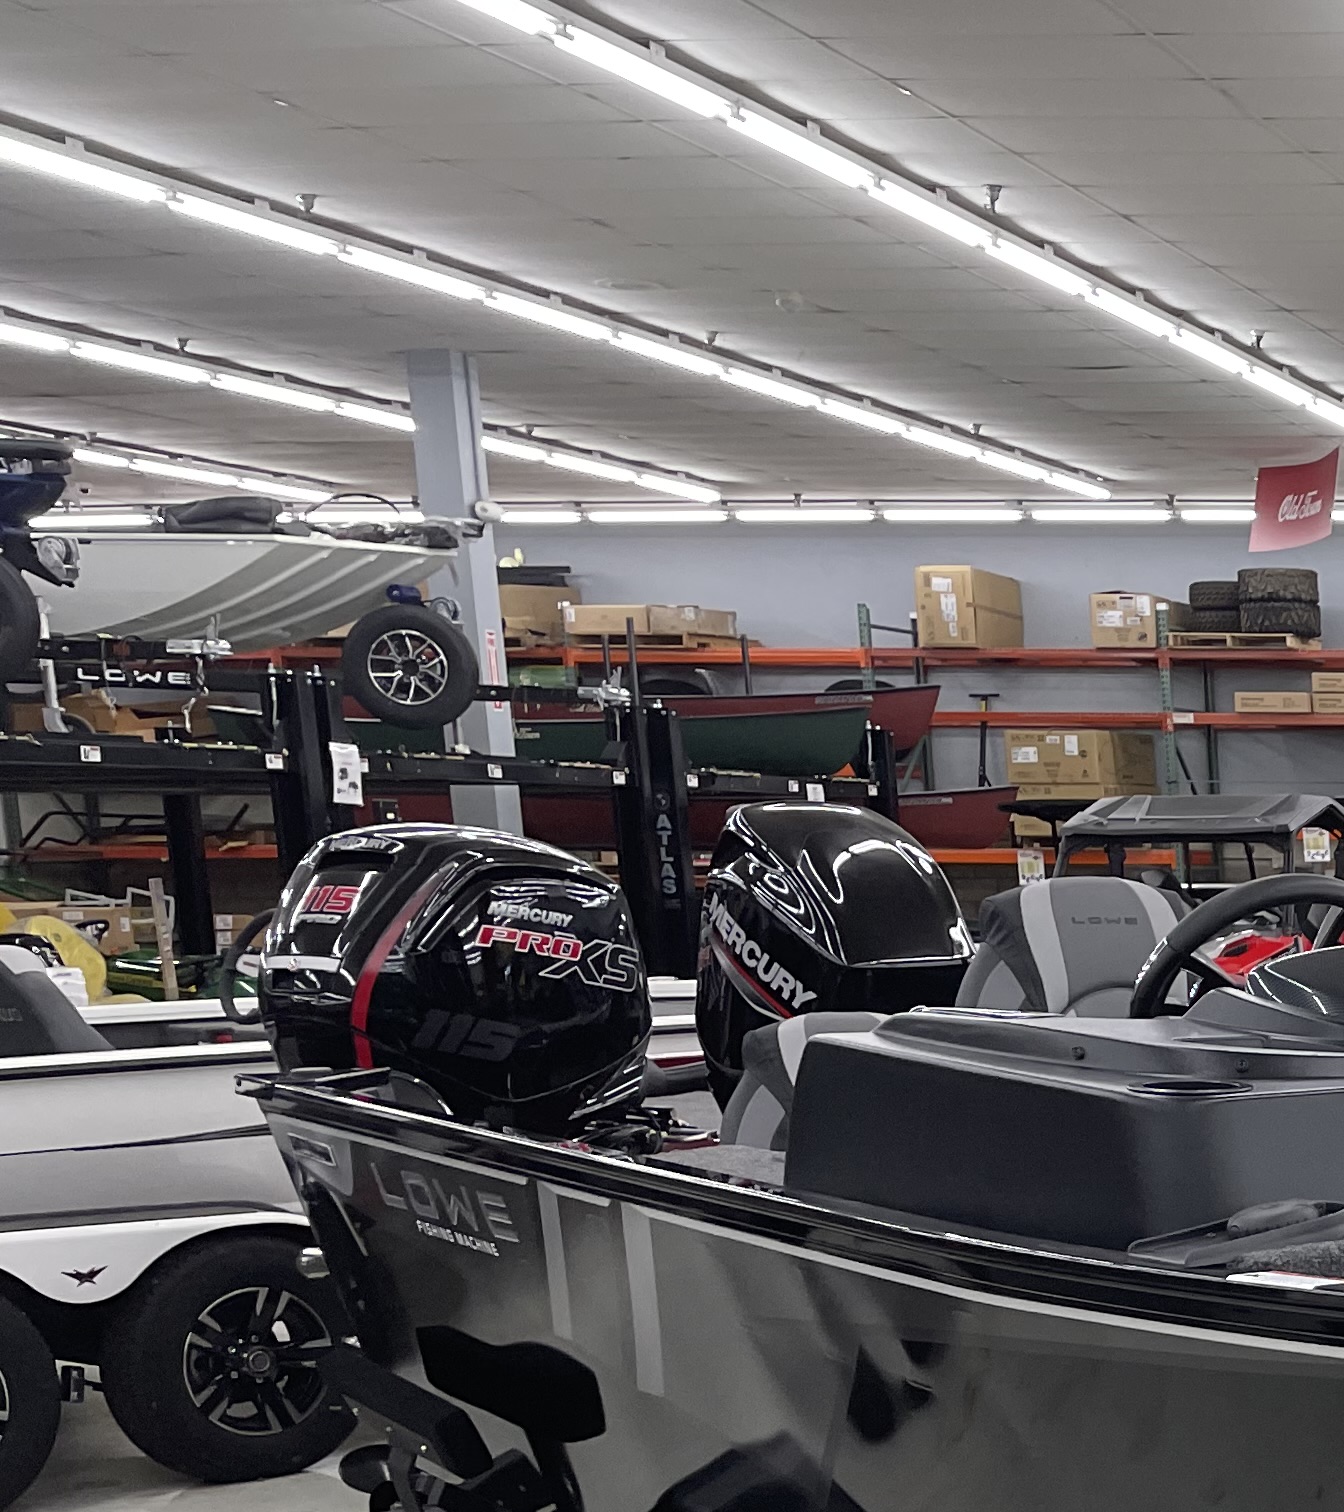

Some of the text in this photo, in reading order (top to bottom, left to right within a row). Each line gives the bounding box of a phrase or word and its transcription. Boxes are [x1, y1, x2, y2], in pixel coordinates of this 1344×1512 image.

[77, 668, 191, 685] LOWE
[656, 814, 677, 894] ATLAS
[301, 885, 361, 914] 115
[487, 900, 573, 928] MERCURY
[1071, 916, 1138, 925] LOWE
[475, 925, 583, 961] PRO
[709, 891, 818, 1009] MERCURY
[411, 1008, 521, 1062] 115
[370, 1162, 520, 1244] LOWE
